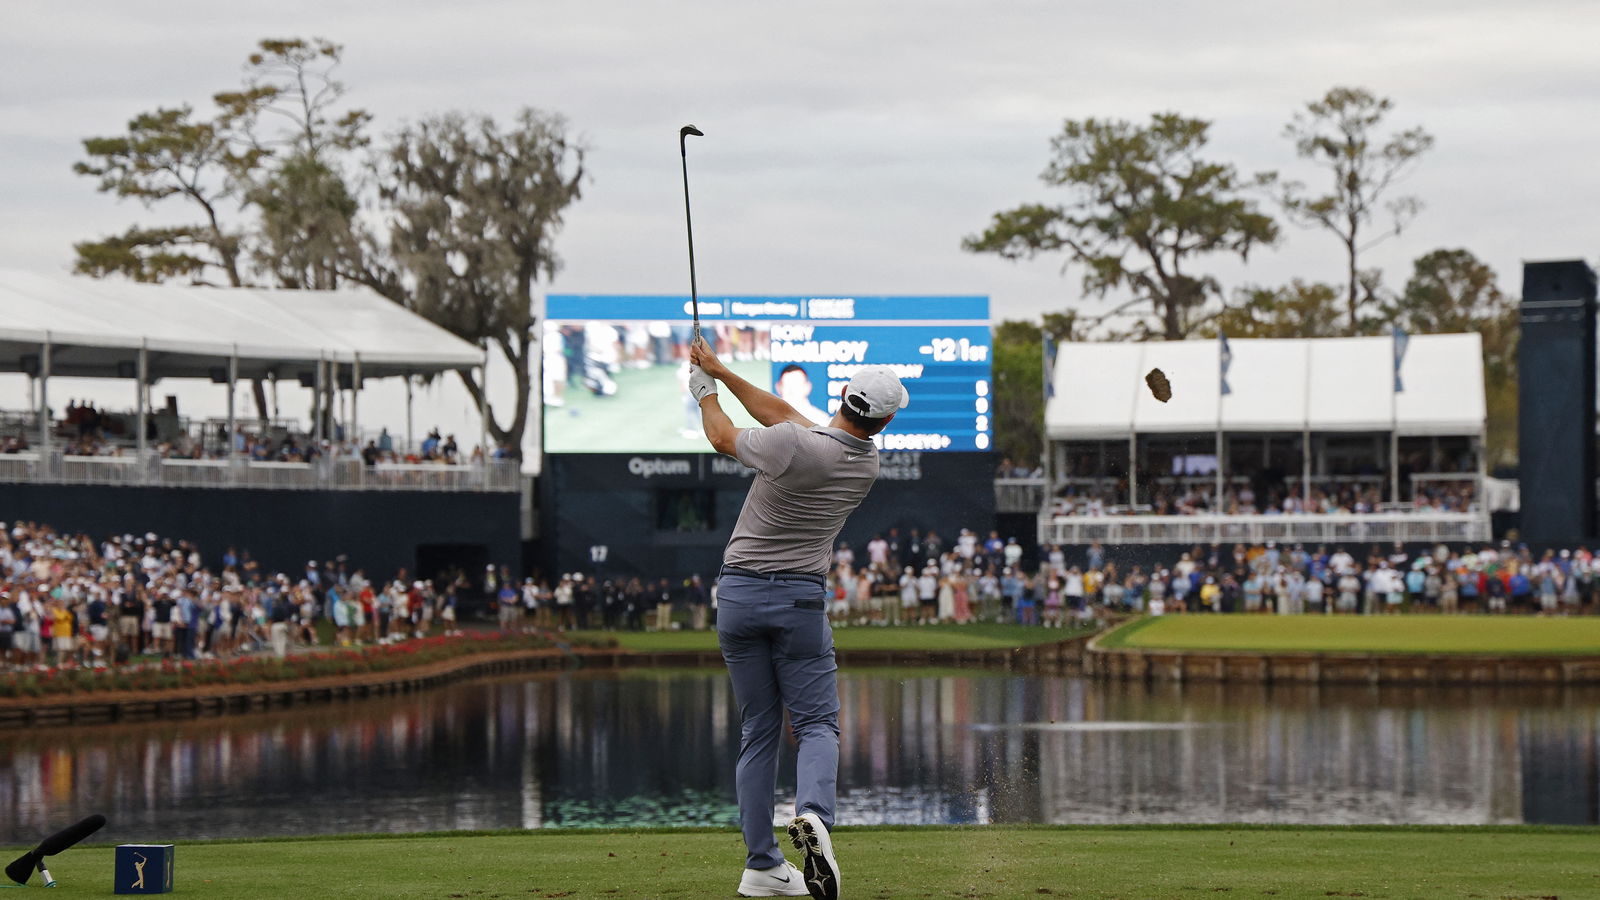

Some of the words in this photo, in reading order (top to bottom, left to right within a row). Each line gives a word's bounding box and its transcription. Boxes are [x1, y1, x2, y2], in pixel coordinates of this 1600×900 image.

[918, 338, 956, 362] -12
[628, 457, 691, 479] Optum
[711, 457, 758, 478] Morg
[590, 545, 608, 562] 17
